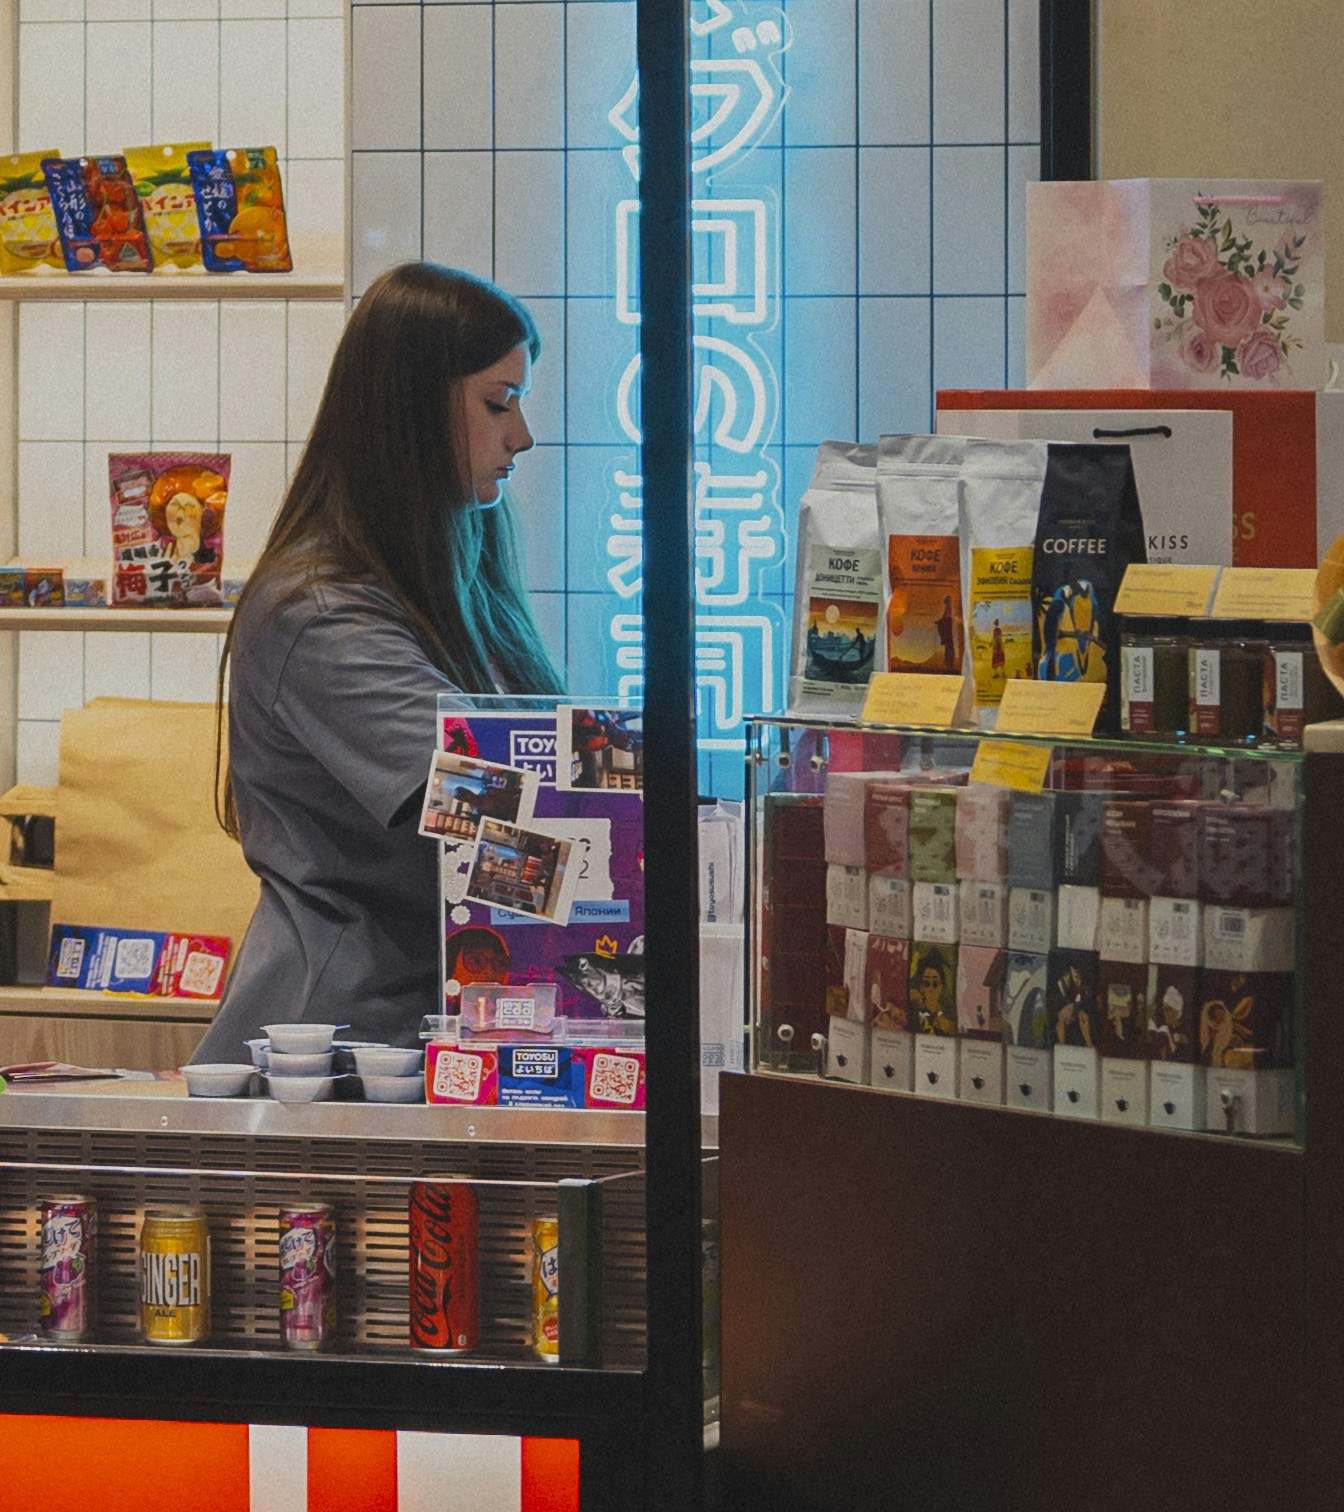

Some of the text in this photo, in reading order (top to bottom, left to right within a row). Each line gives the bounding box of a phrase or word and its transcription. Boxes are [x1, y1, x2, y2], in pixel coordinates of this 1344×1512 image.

[1042, 538, 1107, 555] COFFEE
[1148, 534, 1189, 551] KISS
[910, 548, 941, 563] КОФЕ
[828, 557, 860, 573] КОФЕ
[989, 560, 1018, 574] КОФЕ
[1134, 655, 1142, 694] ПАСТА
[1200, 658, 1209, 699] ПАСТА
[1280, 661, 1289, 702] ПАСТА
[516, 1052, 555, 1062] TOYOSU
[140, 1252, 202, 1306] GINGER
